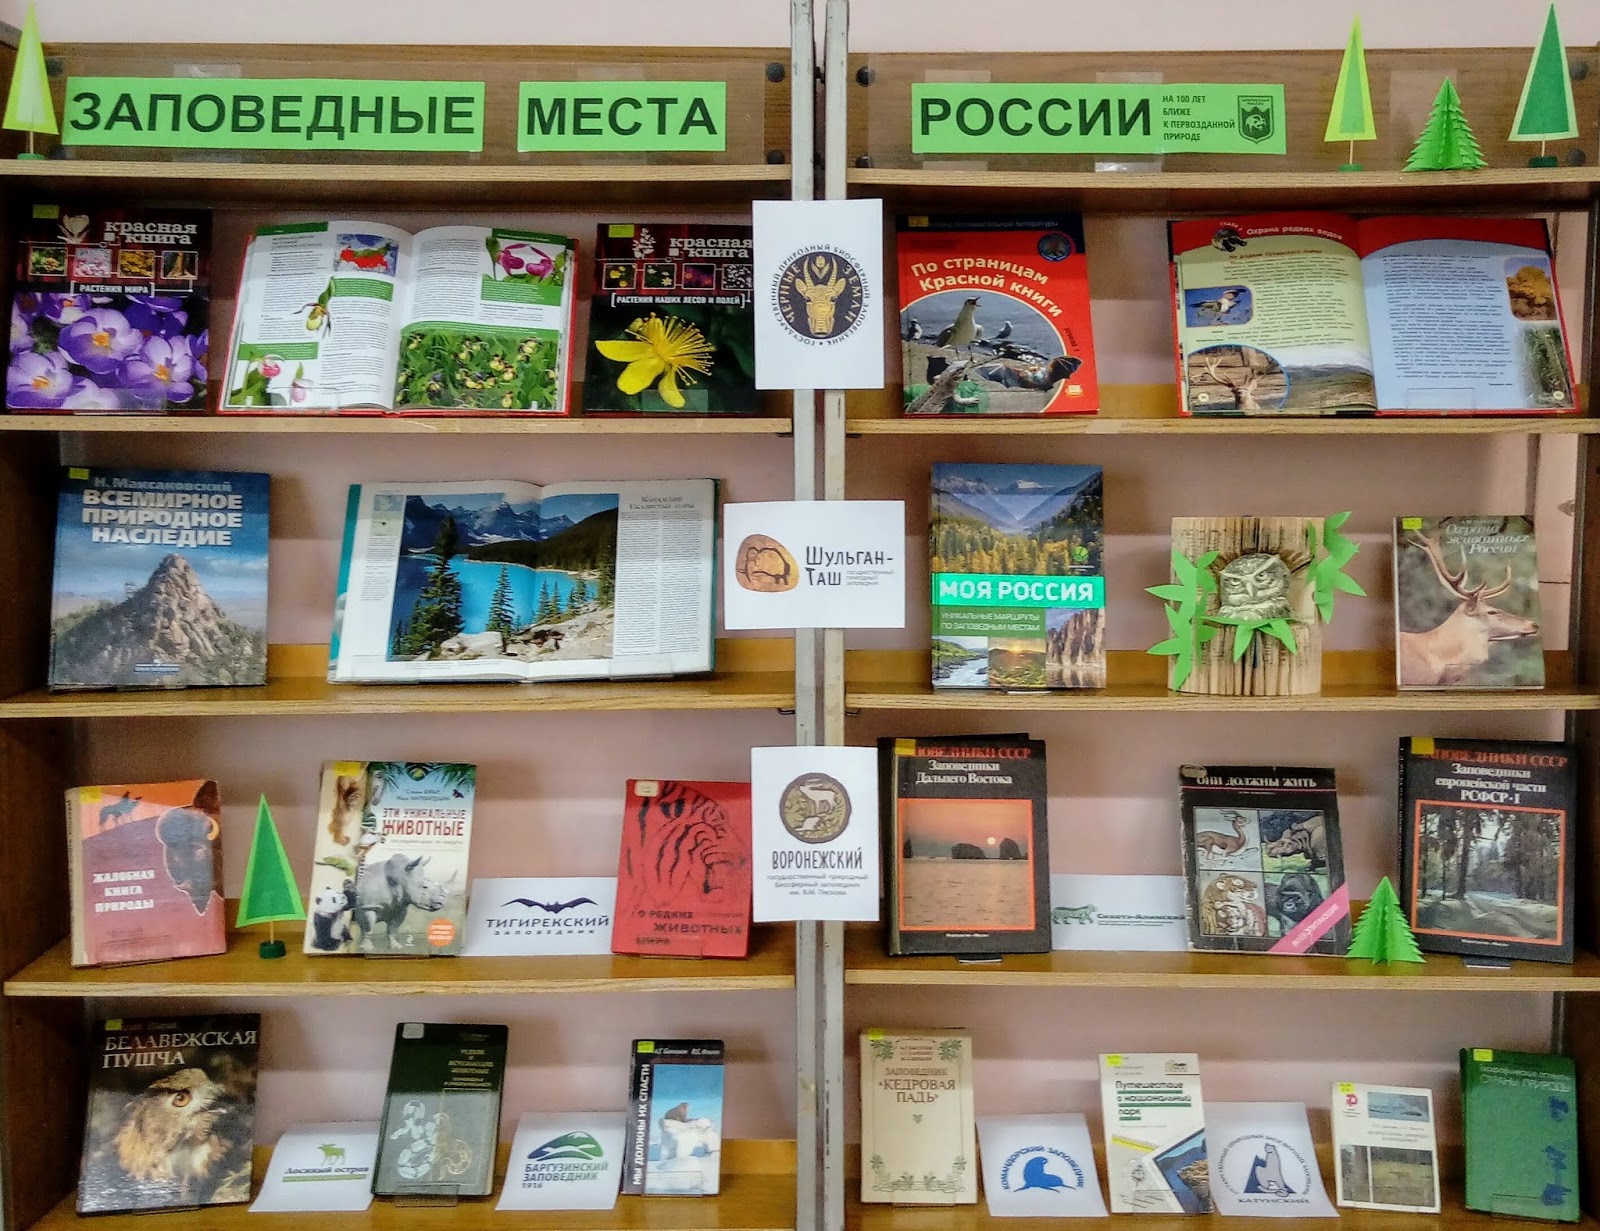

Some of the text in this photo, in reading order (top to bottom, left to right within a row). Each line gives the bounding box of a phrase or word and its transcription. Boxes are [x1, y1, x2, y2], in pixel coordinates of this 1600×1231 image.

[1162, 95, 1206, 103] НА 100 ЛЕТ
[70, 93, 718, 140] ЗАПОВЕДНЫЕ МЕСТА
[920, 97, 1151, 136] РОССИИ
[1162, 108, 1191, 116] БЛИЖЕ
[1170, 119, 1236, 130] ПЕРВОЗДАННОЙ
[1163, 133, 1201, 141] ПРИРОДЕ
[104, 221, 198, 235] красная
[124, 233, 192, 244] книга
[669, 237, 753, 250] красная
[687, 248, 749, 258] книга
[911, 257, 1049, 285] По страницам
[79, 284, 149, 294] РАСТЕНИЯ МИРА
[770, 244, 870, 346] ГОСУДАРСТВЕННЫЙ ПРИРОДНЫЙ БИОСФЕРНЫЙ ЗАПОВЕДНИК
[779, 263, 862, 323] ЧЕРНЫЕ ЗЕМЛИ
[919, 274, 1063, 318] Красной книги
[682, 296, 707, 304] ЛЕСОВ
[715, 295, 740, 304] ПОЛЕЙ
[113, 477, 233, 492] Максаковский
[81, 488, 243, 510] ВСЕМИРНОЕ
[81, 507, 243, 528] ПРИРОДНОЕ
[91, 527, 233, 548] НАСЛЕДИЕ
[805, 546, 894, 567] Шульган-
[804, 567, 842, 586] Таш
[940, 580, 1094, 602] МОЯ РОССИЯ
[998, 747, 1031, 759] СССР
[928, 759, 1000, 771] Заповедники
[1451, 762, 1531, 778] Заповедники
[915, 772, 1013, 784] Дальнего Востока
[1434, 777, 1547, 793] европейской части
[383, 807, 400, 817] ЭТИ
[382, 820, 464, 836] ЖИВОТНЫЕ
[772, 846, 863, 870] ВОРОНЕЖСКИЙ
[104, 885, 143, 897] КНИГА
[95, 899, 154, 912] ПРИРОДЫ
[486, 915, 609, 928] ТИГИРЕКСКИЙ
[654, 922, 742, 934] ЖИВОТНЫХ
[105, 1030, 257, 1050] БЕЛАВЕЖСКАЯ
[102, 1050, 185, 1069] ПУШЧА
[1115, 1080, 1184, 1090] Путешествие
[1124, 1094, 1192, 1102] национальный
[632, 1063, 650, 1185] МЫ ДОЛЖНЫ ИХ СПАСТИ
[525, 1161, 609, 1172] БАРГУЗИНСКИЙ
[1001, 1145, 1045, 1190] КОМАНДОРСКИЙ
[522, 1172, 598, 1182] ЗАПОВЕДНИК
